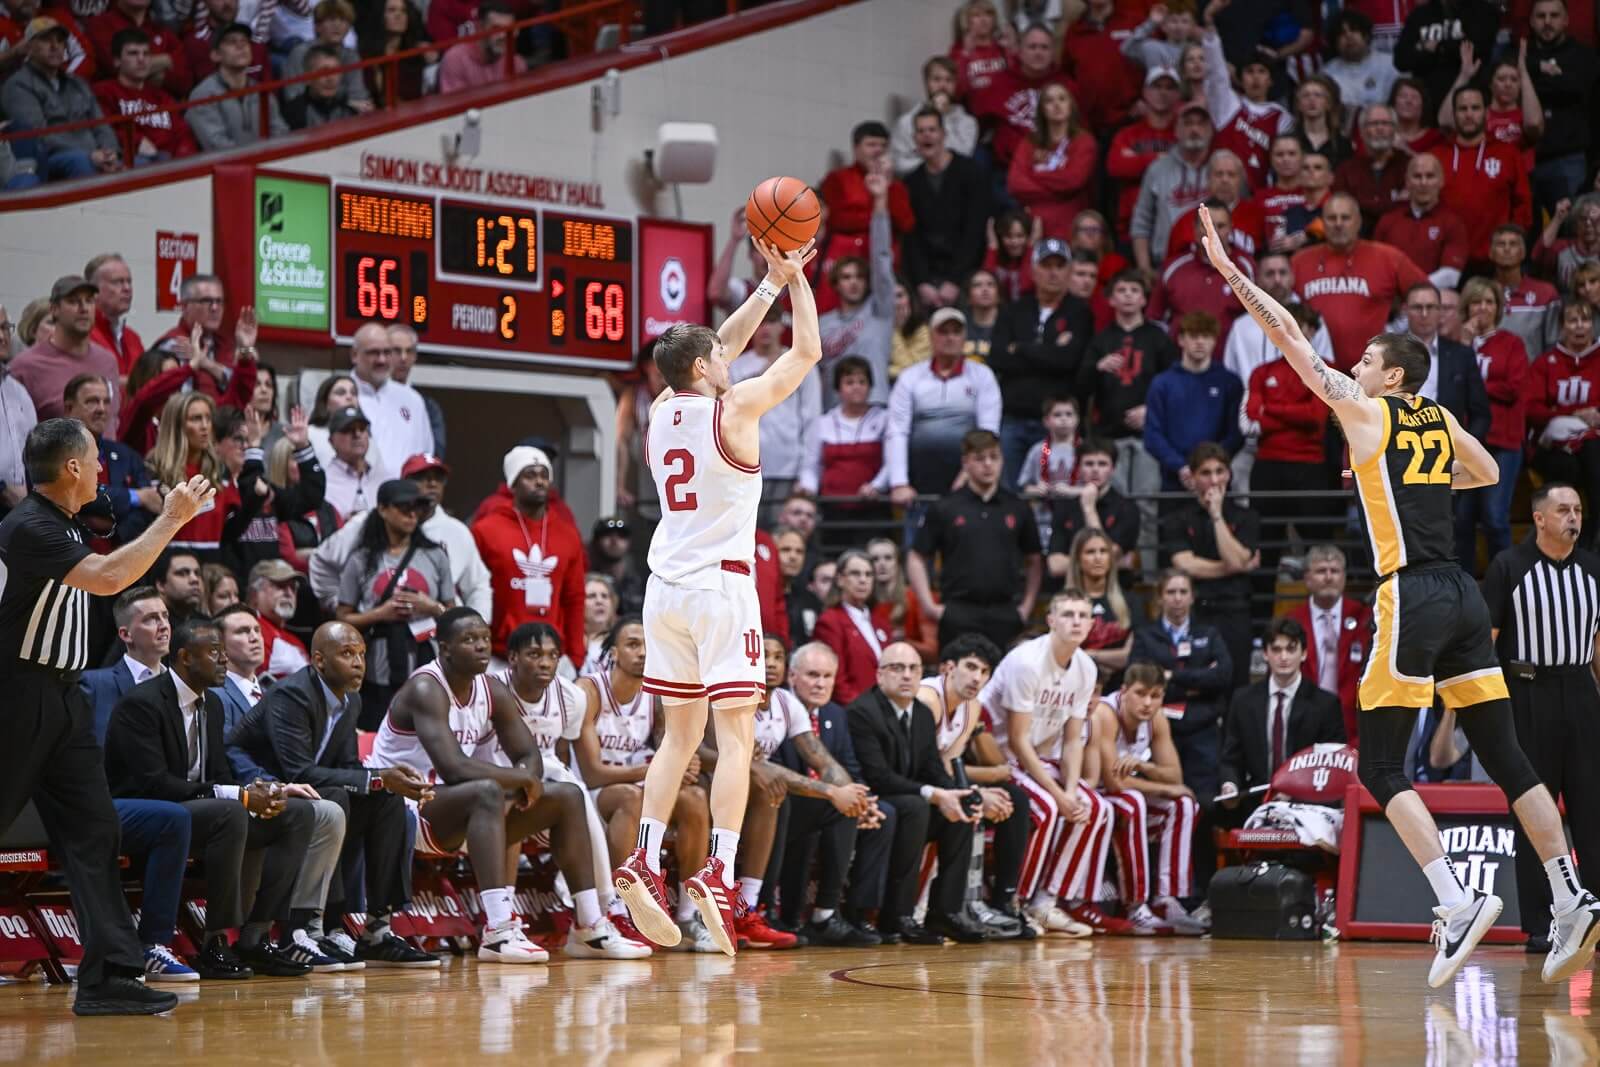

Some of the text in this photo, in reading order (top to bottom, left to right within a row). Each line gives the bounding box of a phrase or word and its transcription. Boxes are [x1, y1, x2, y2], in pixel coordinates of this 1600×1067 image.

[366, 154, 418, 183] SIMON
[487, 171, 565, 204] ASSEMBLY
[567, 182, 605, 210] HALL
[340, 193, 433, 239] INDIANA
[159, 238, 196, 259] SECTION
[259, 235, 311, 263] Greene
[476, 215, 536, 275] 1:27
[562, 220, 616, 261] IOWA
[170, 261, 182, 303] 4
[357, 257, 399, 319] 66
[1304, 276, 1370, 299] INDIANA
[452, 303, 497, 334] PERIOD
[500, 295, 517, 340] 2
[585, 282, 624, 342] 68
[1396, 430, 1452, 485] 22
[663, 448, 698, 512] 2
[1288, 752, 1354, 773] INDIANA
[1438, 824, 1516, 858] NDIAN
